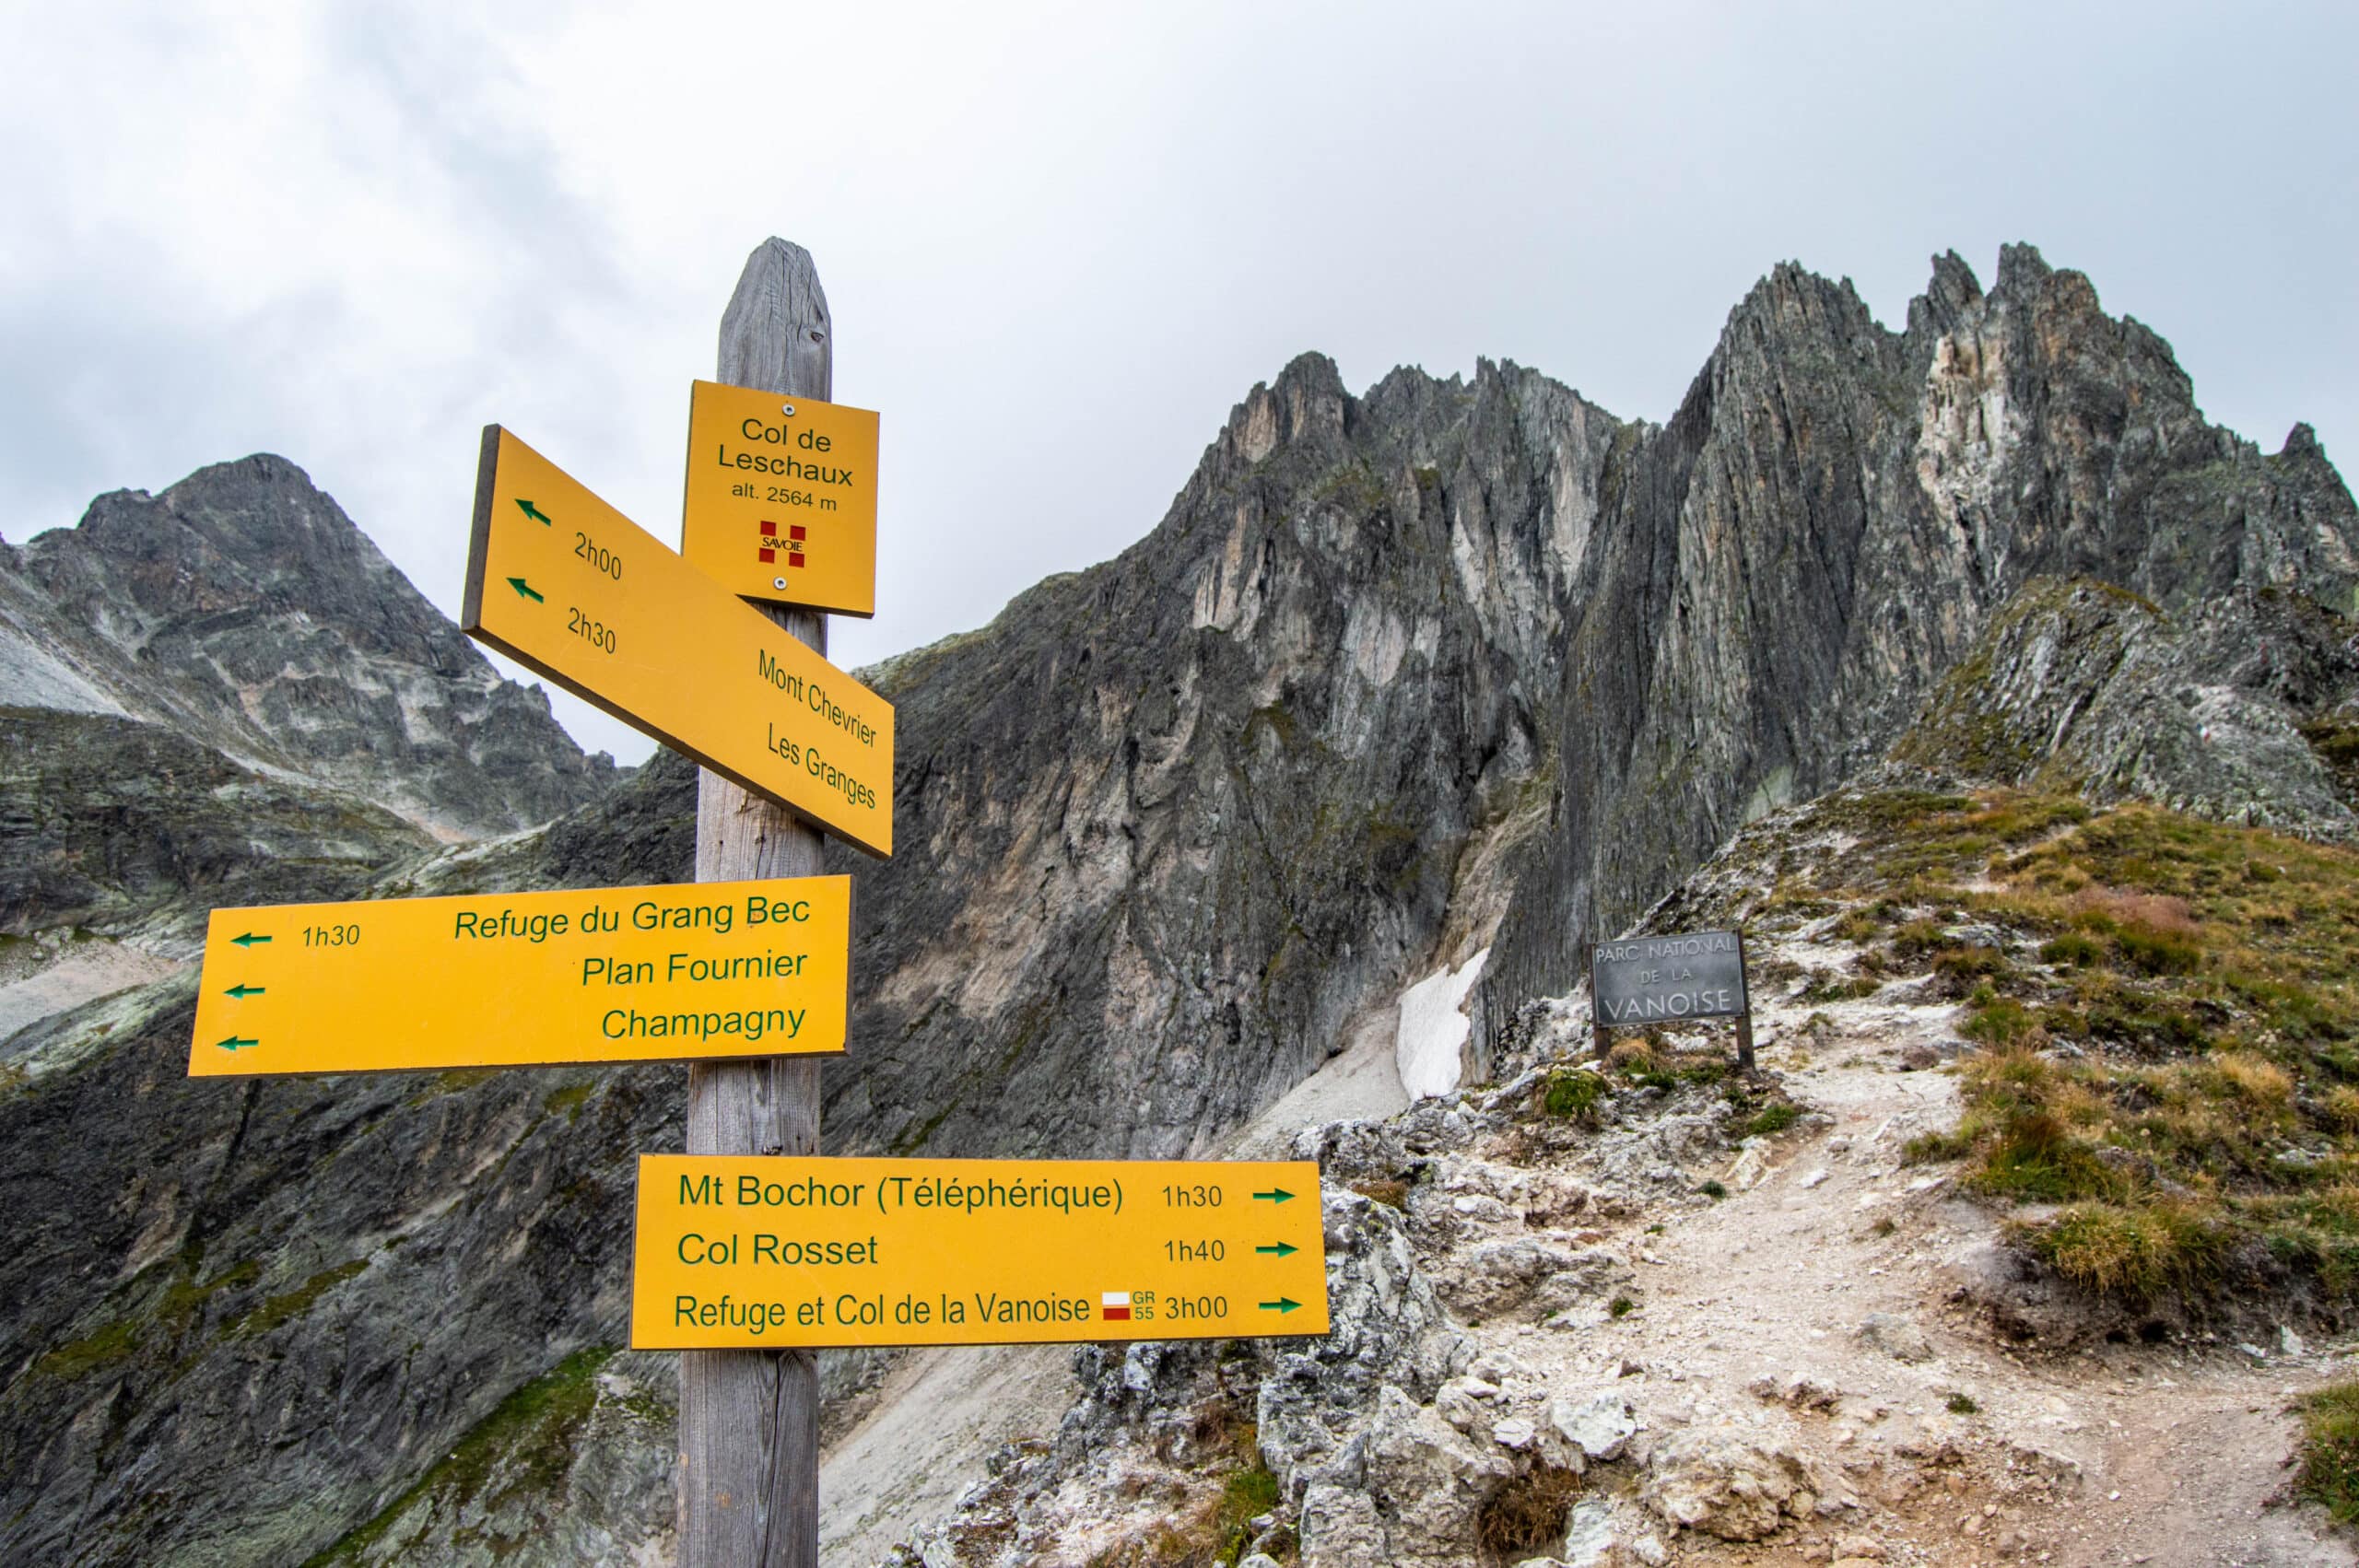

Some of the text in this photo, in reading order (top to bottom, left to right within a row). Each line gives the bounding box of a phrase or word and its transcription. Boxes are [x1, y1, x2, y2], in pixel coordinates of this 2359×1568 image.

[741, 417, 831, 452] Col de
[719, 444, 853, 487] Leschaux
[732, 482, 838, 512] alt. 2564 m
[574, 531, 622, 581] 2h00
[762, 537, 803, 552] SAVOIE
[567, 606, 616, 655] 2h30
[758, 648, 877, 747] Mont Chevrier
[768, 721, 876, 810] Les Granges
[454, 895, 810, 943] Refuge du Grang Bec
[302, 924, 360, 947] 1h30
[1596, 937, 1735, 964] PARC NATIONAL
[582, 949, 808, 987] Plan Fournier
[1641, 968, 1693, 984] DE LA
[1605, 989, 1732, 1021] VANOISE
[602, 1009, 806, 1042] Champagny
[679, 1174, 1122, 1215] Mt Bochor (Téléphérique)
[1162, 1185, 1223, 1208] 1h30
[677, 1233, 878, 1265] Col Rosset
[1164, 1239, 1225, 1262] 1h40
[675, 1292, 1090, 1336] Refuge et Col de la Vanoise
[1132, 1291, 1156, 1305] GR
[1134, 1305, 1155, 1320] 55
[1165, 1295, 1228, 1320] 3h00
